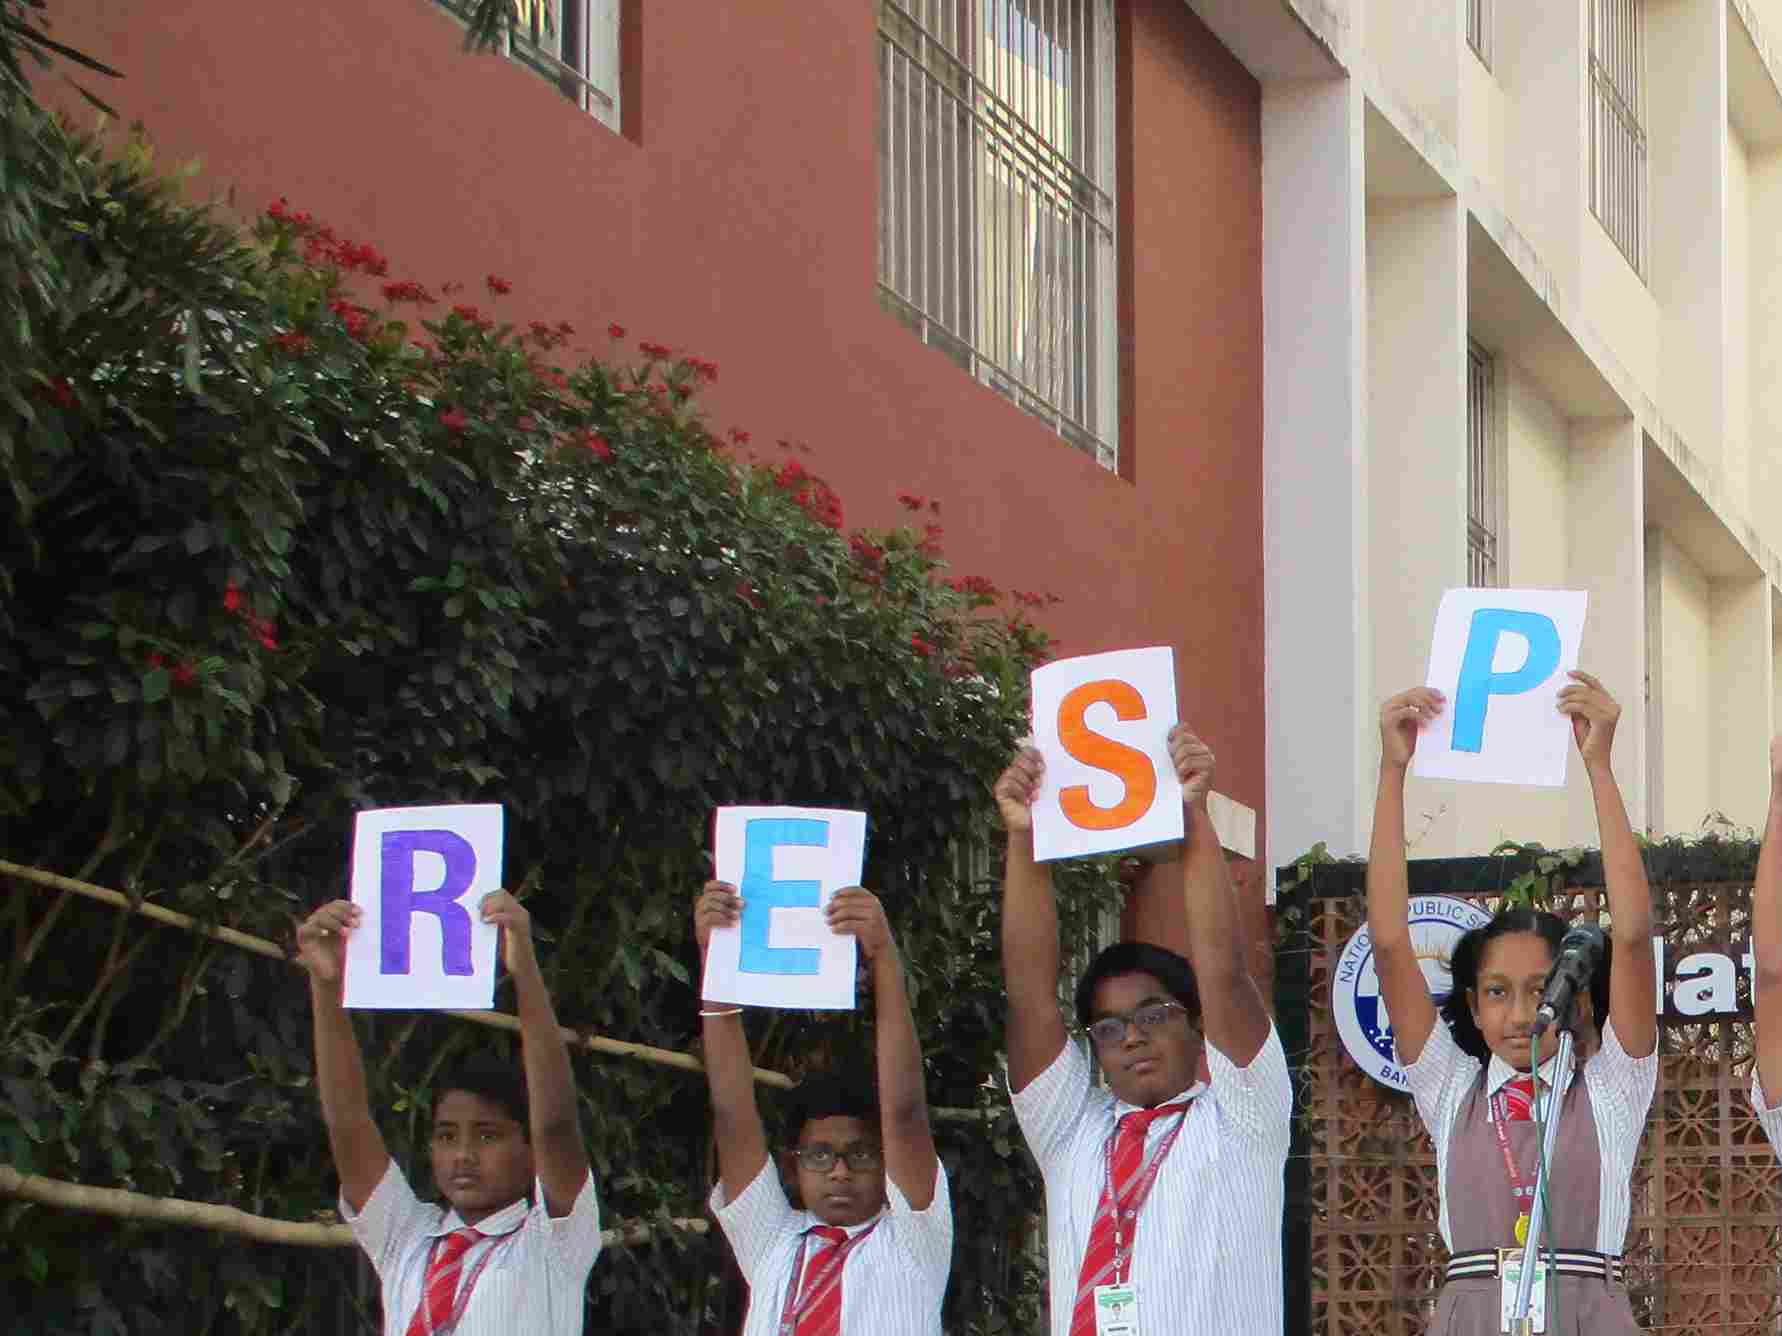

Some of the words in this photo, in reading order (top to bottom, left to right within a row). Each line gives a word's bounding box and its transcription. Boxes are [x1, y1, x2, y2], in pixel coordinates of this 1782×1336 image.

[1057, 678, 1157, 831] S
[1451, 608, 1562, 754] P
[379, 829, 478, 977] R
[737, 818, 830, 976] E
